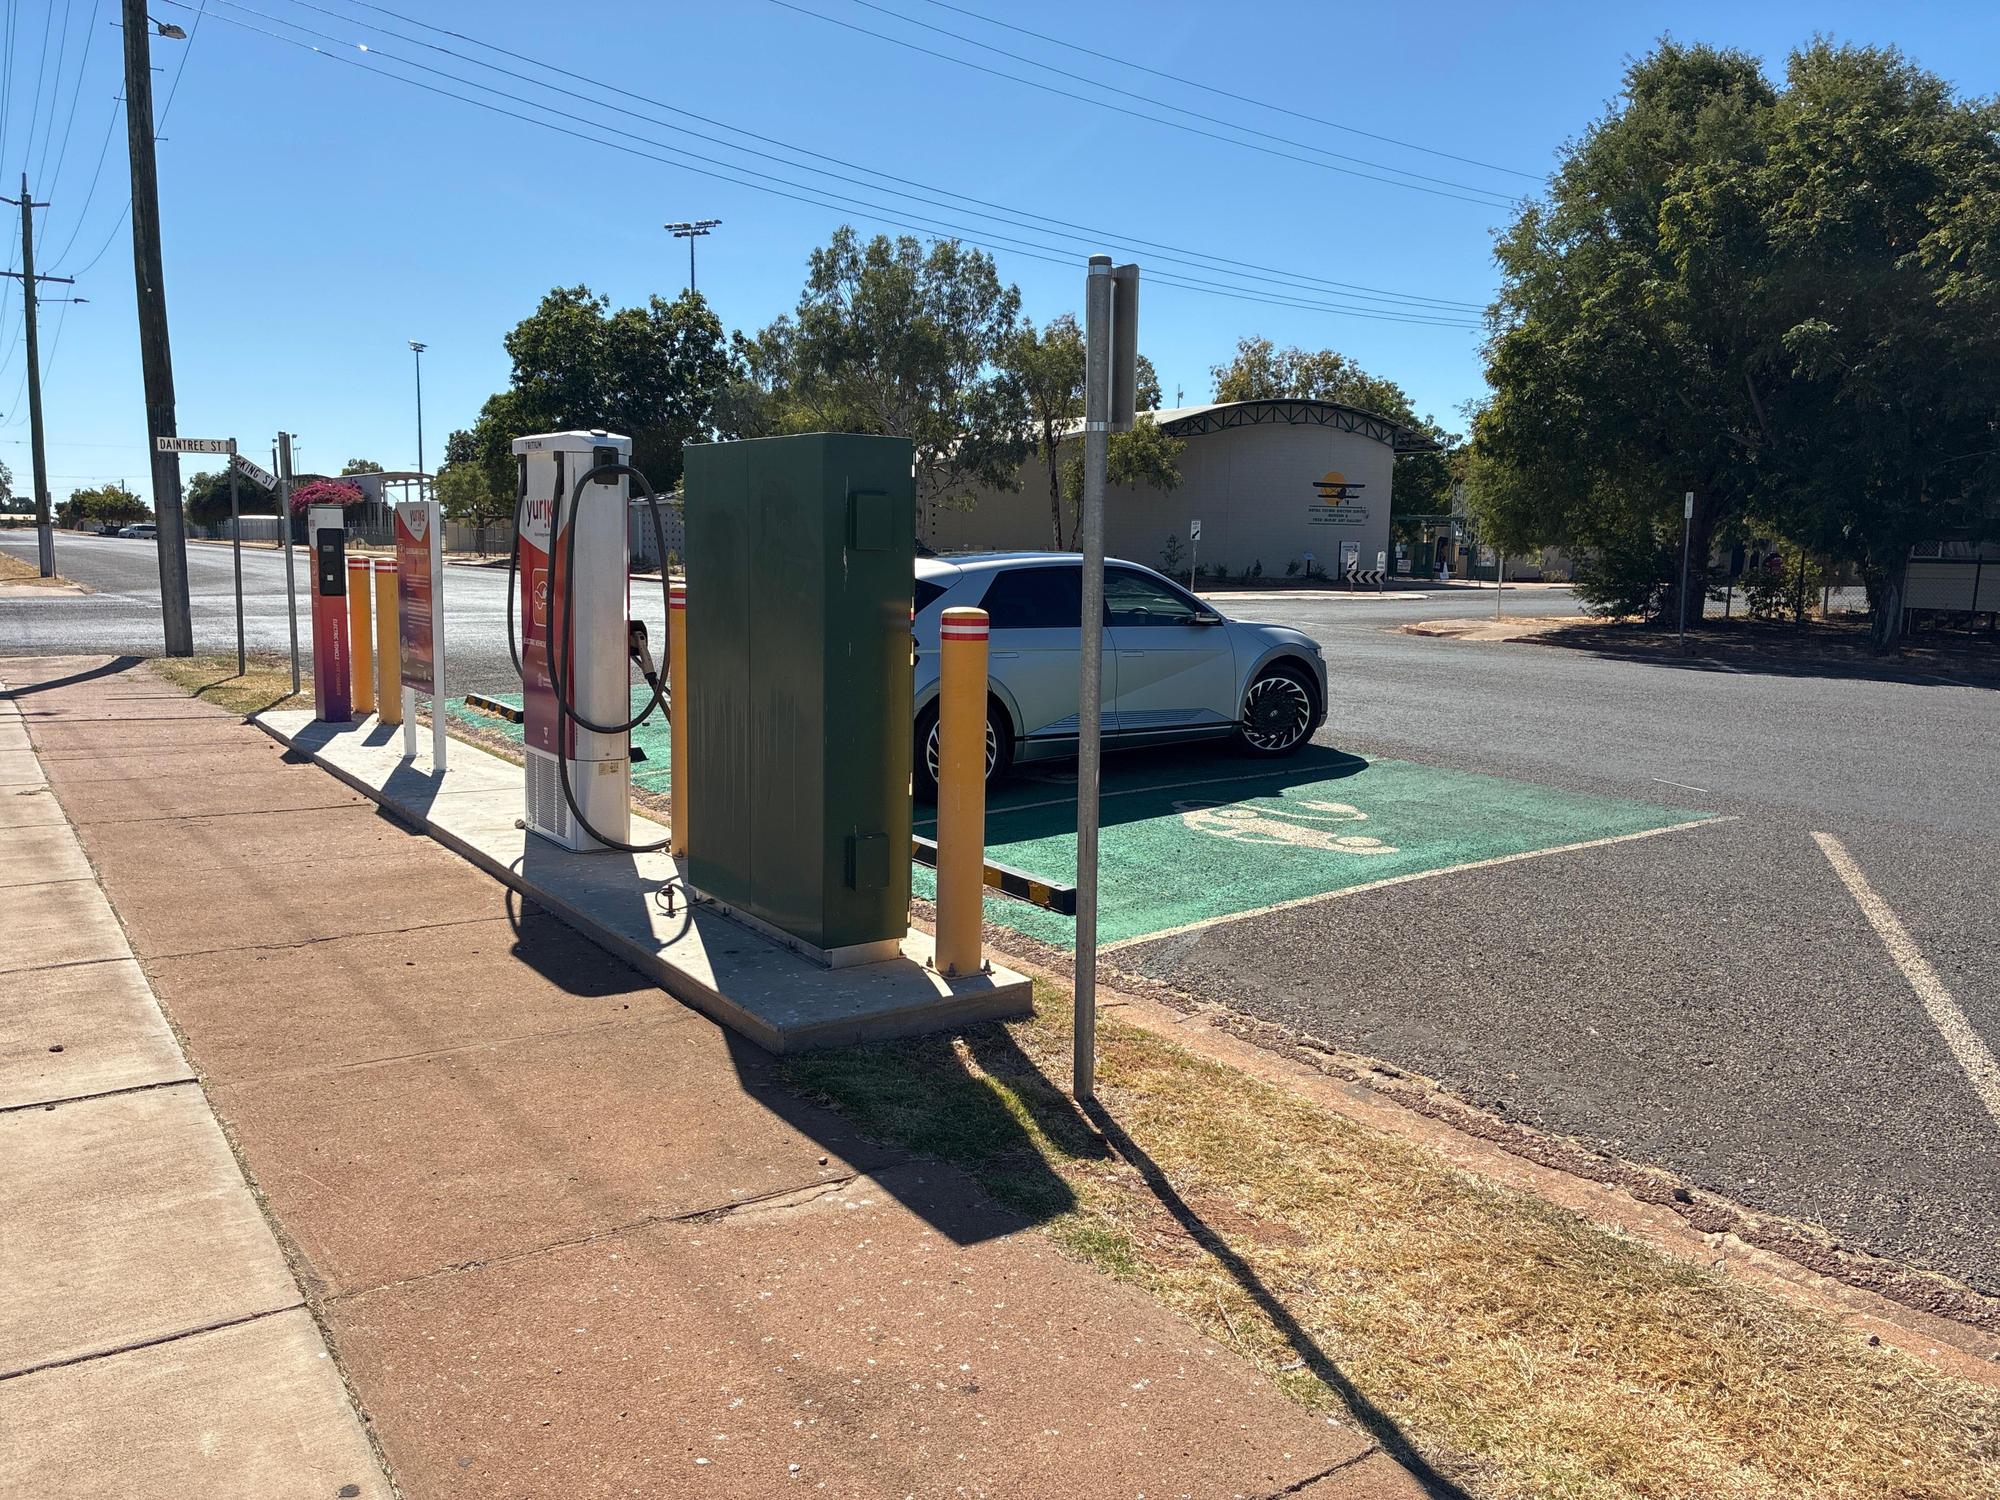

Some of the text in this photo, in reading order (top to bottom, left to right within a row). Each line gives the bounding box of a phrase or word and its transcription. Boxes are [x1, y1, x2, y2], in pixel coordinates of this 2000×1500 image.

[160, 440, 222, 452] DAINTREE ST
[525, 440, 542, 450] TRITIUM
[241, 460, 275, 487] KING ST
[526, 499, 553, 529] yurik
